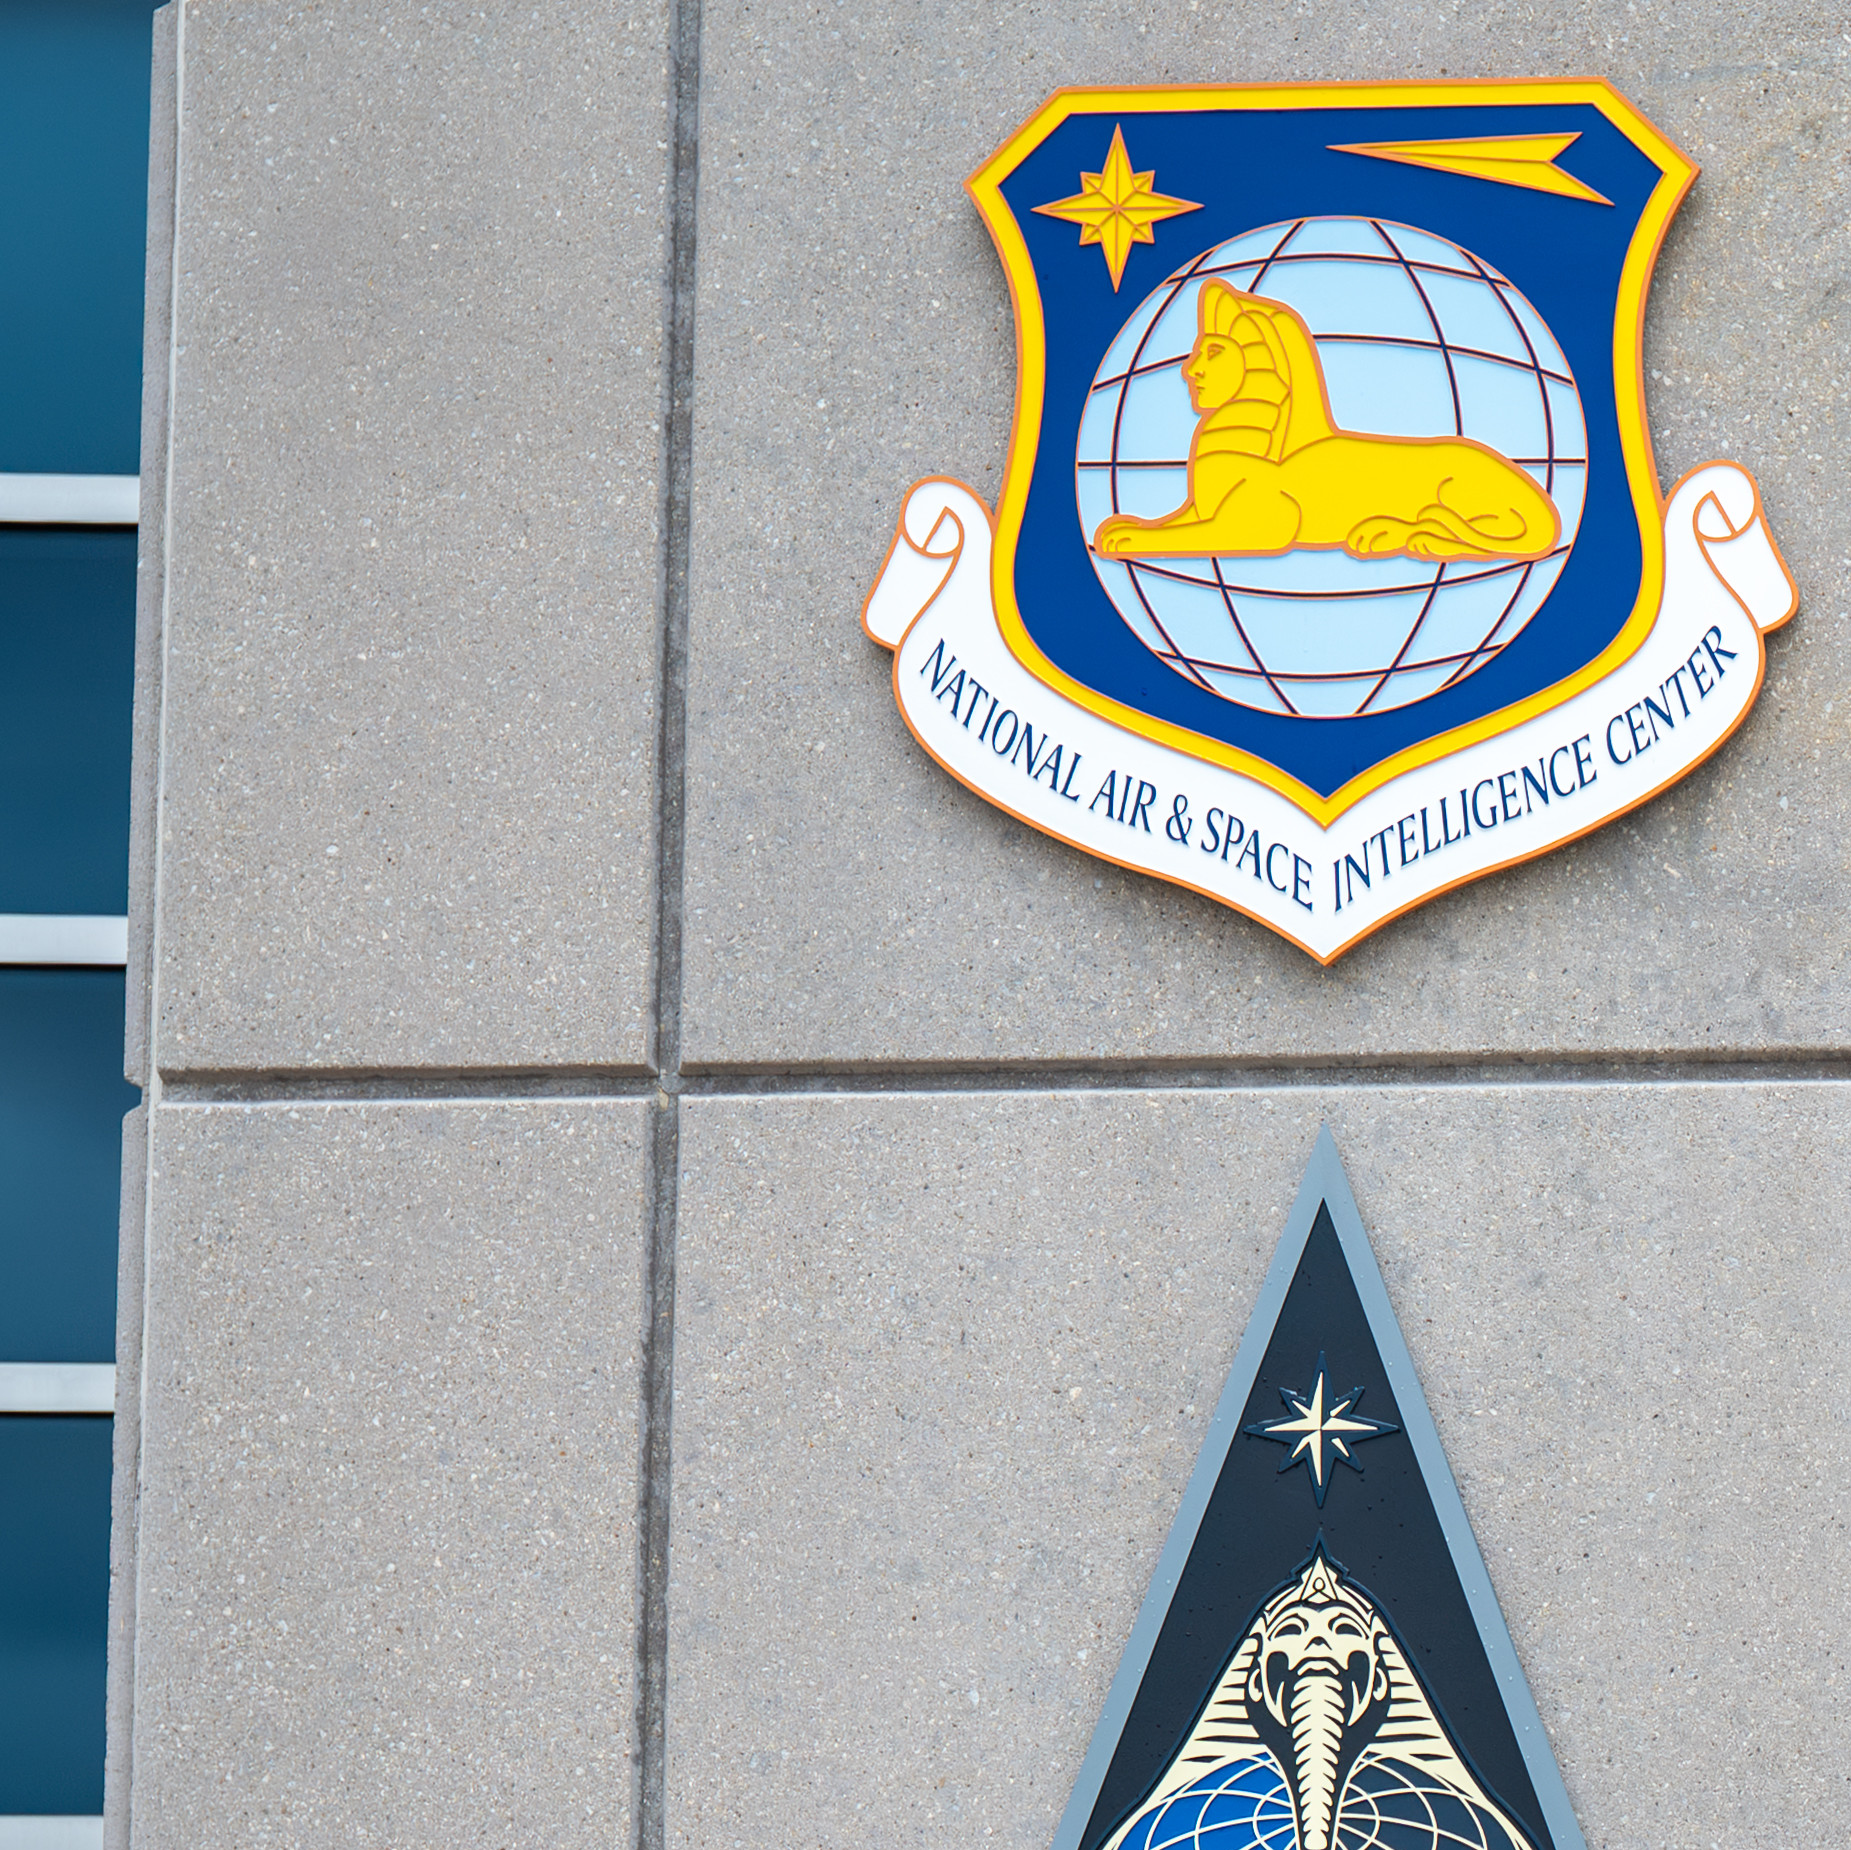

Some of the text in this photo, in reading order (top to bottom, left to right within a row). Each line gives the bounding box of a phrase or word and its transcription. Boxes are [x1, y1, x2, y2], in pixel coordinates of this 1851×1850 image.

[919, 624, 1739, 914] NATIONAL AIR & SPACE INTELLIGENCE CENTER
